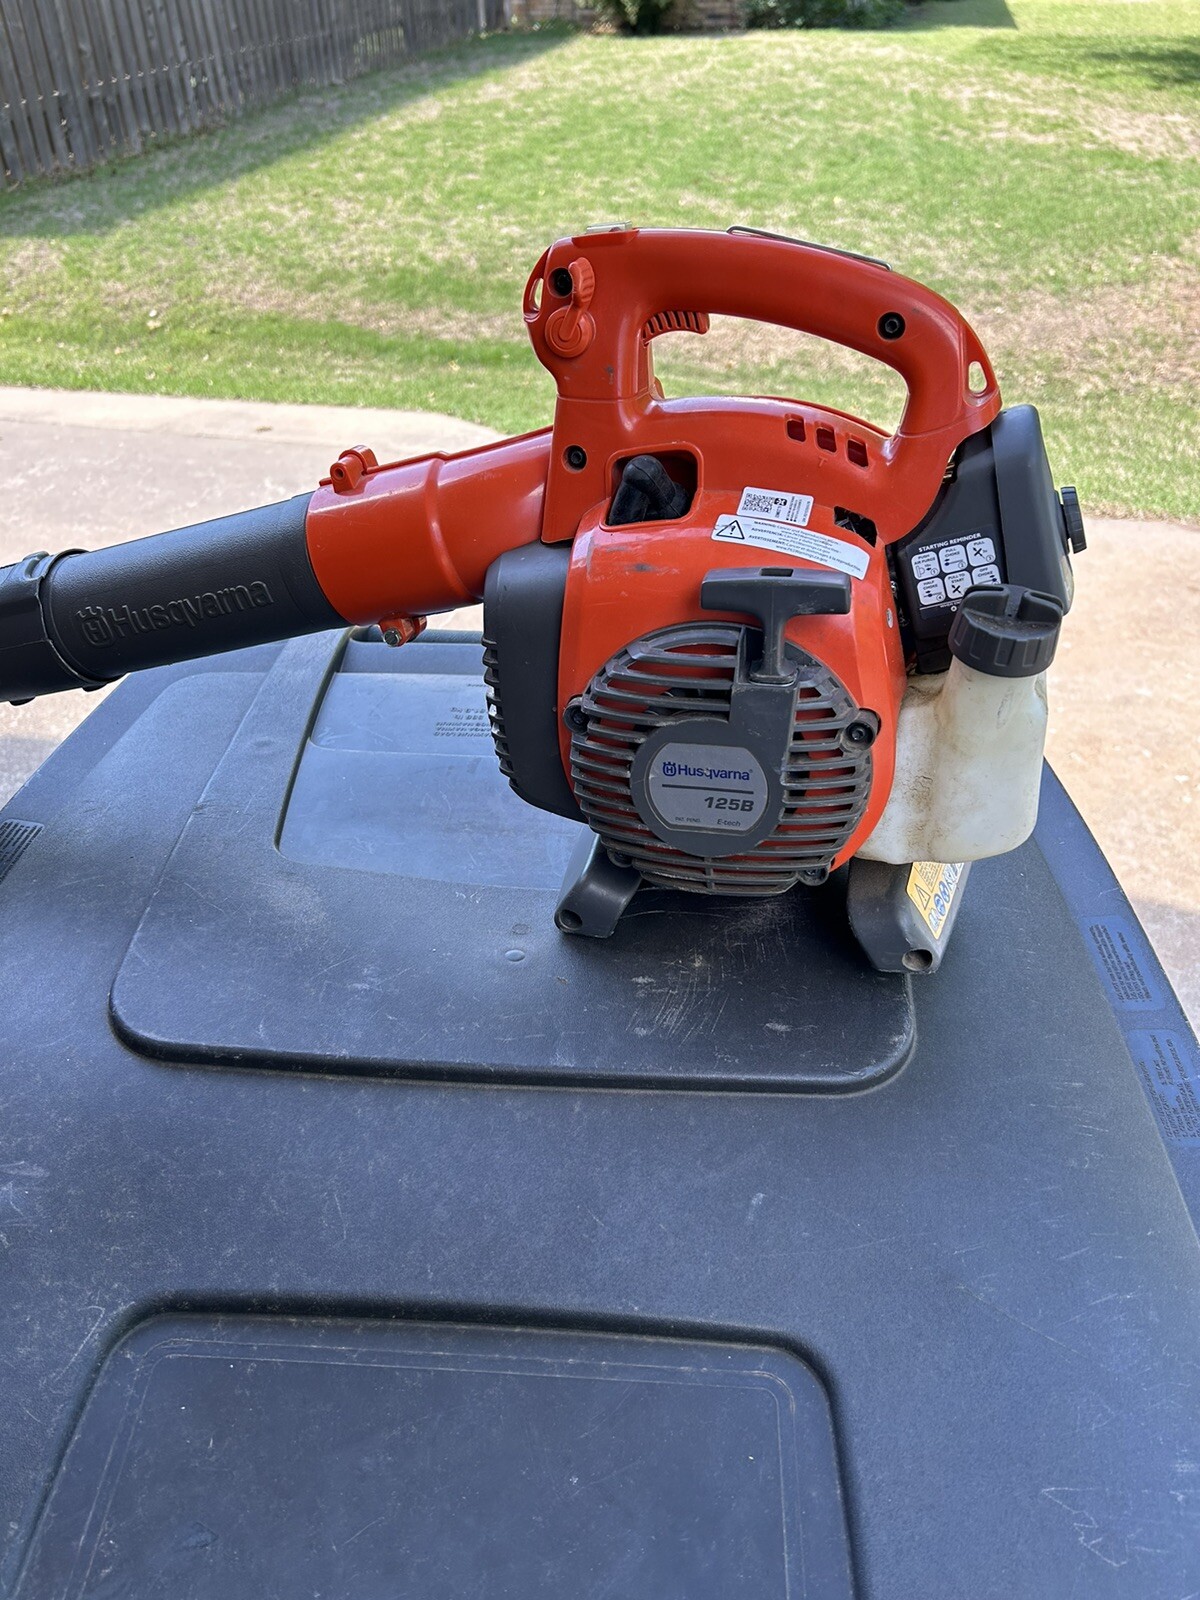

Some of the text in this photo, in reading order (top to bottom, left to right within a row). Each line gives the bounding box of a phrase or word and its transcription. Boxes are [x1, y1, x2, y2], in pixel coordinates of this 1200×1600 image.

[919, 533, 981, 552] STARTING REMINDER
[108, 580, 275, 638] Husqvarna
[678, 764, 750, 781] Husqvarna
[704, 796, 754, 812] 125B
[717, 818, 741, 827] E-tech
